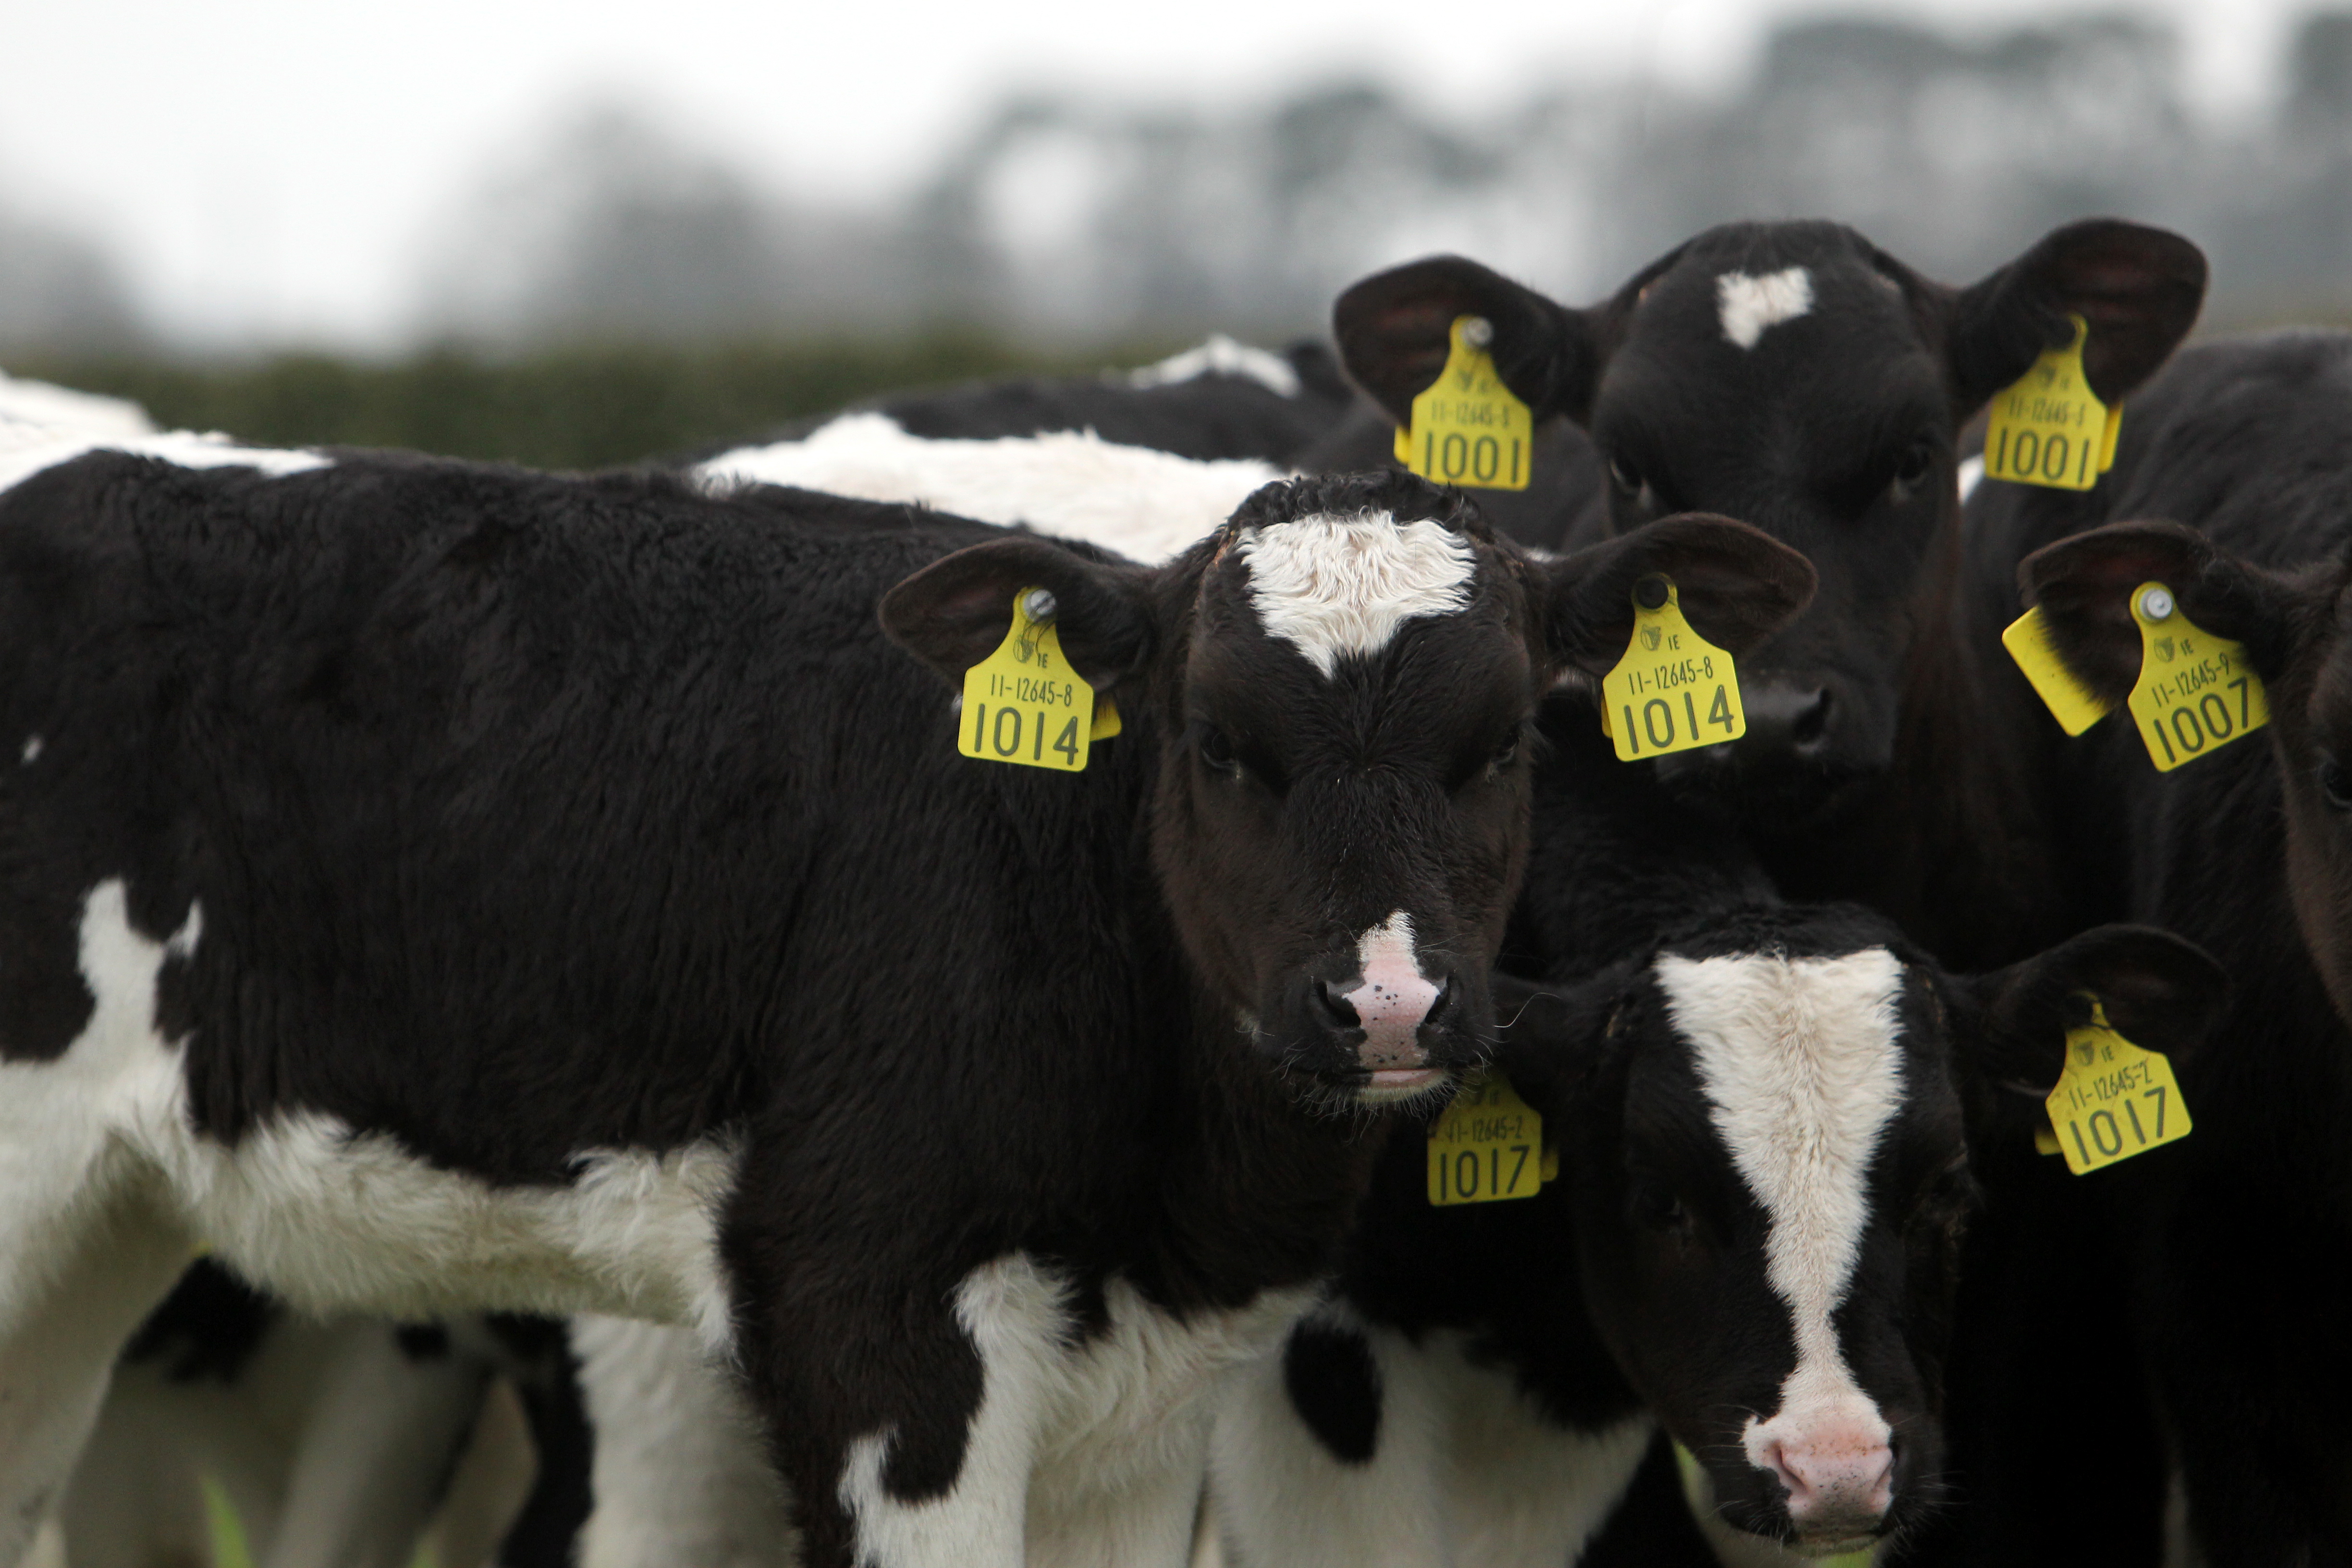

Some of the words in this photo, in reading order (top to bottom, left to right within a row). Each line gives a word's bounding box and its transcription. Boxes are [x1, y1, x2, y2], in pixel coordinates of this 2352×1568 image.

[1424, 432, 1519, 484] 1001
[1997, 427, 2090, 485] 1001
[1038, 653, 1048, 668] IE
[1668, 635, 1680, 650] IE
[2180, 638, 2194, 656] IE
[991, 674, 1072, 707] 11-12645-8
[1629, 656, 1713, 695] 11-12645-8
[2152, 652, 2230, 708] 11-12645-9
[974, 703, 1078, 765] 1014
[1624, 684, 1734, 754] 1014
[2153, 676, 2249, 763] 1007
[2069, 1060, 2153, 1110] 11-12645-2
[2070, 1086, 2166, 1165] 1017
[1440, 1144, 1531, 1200] 1017
